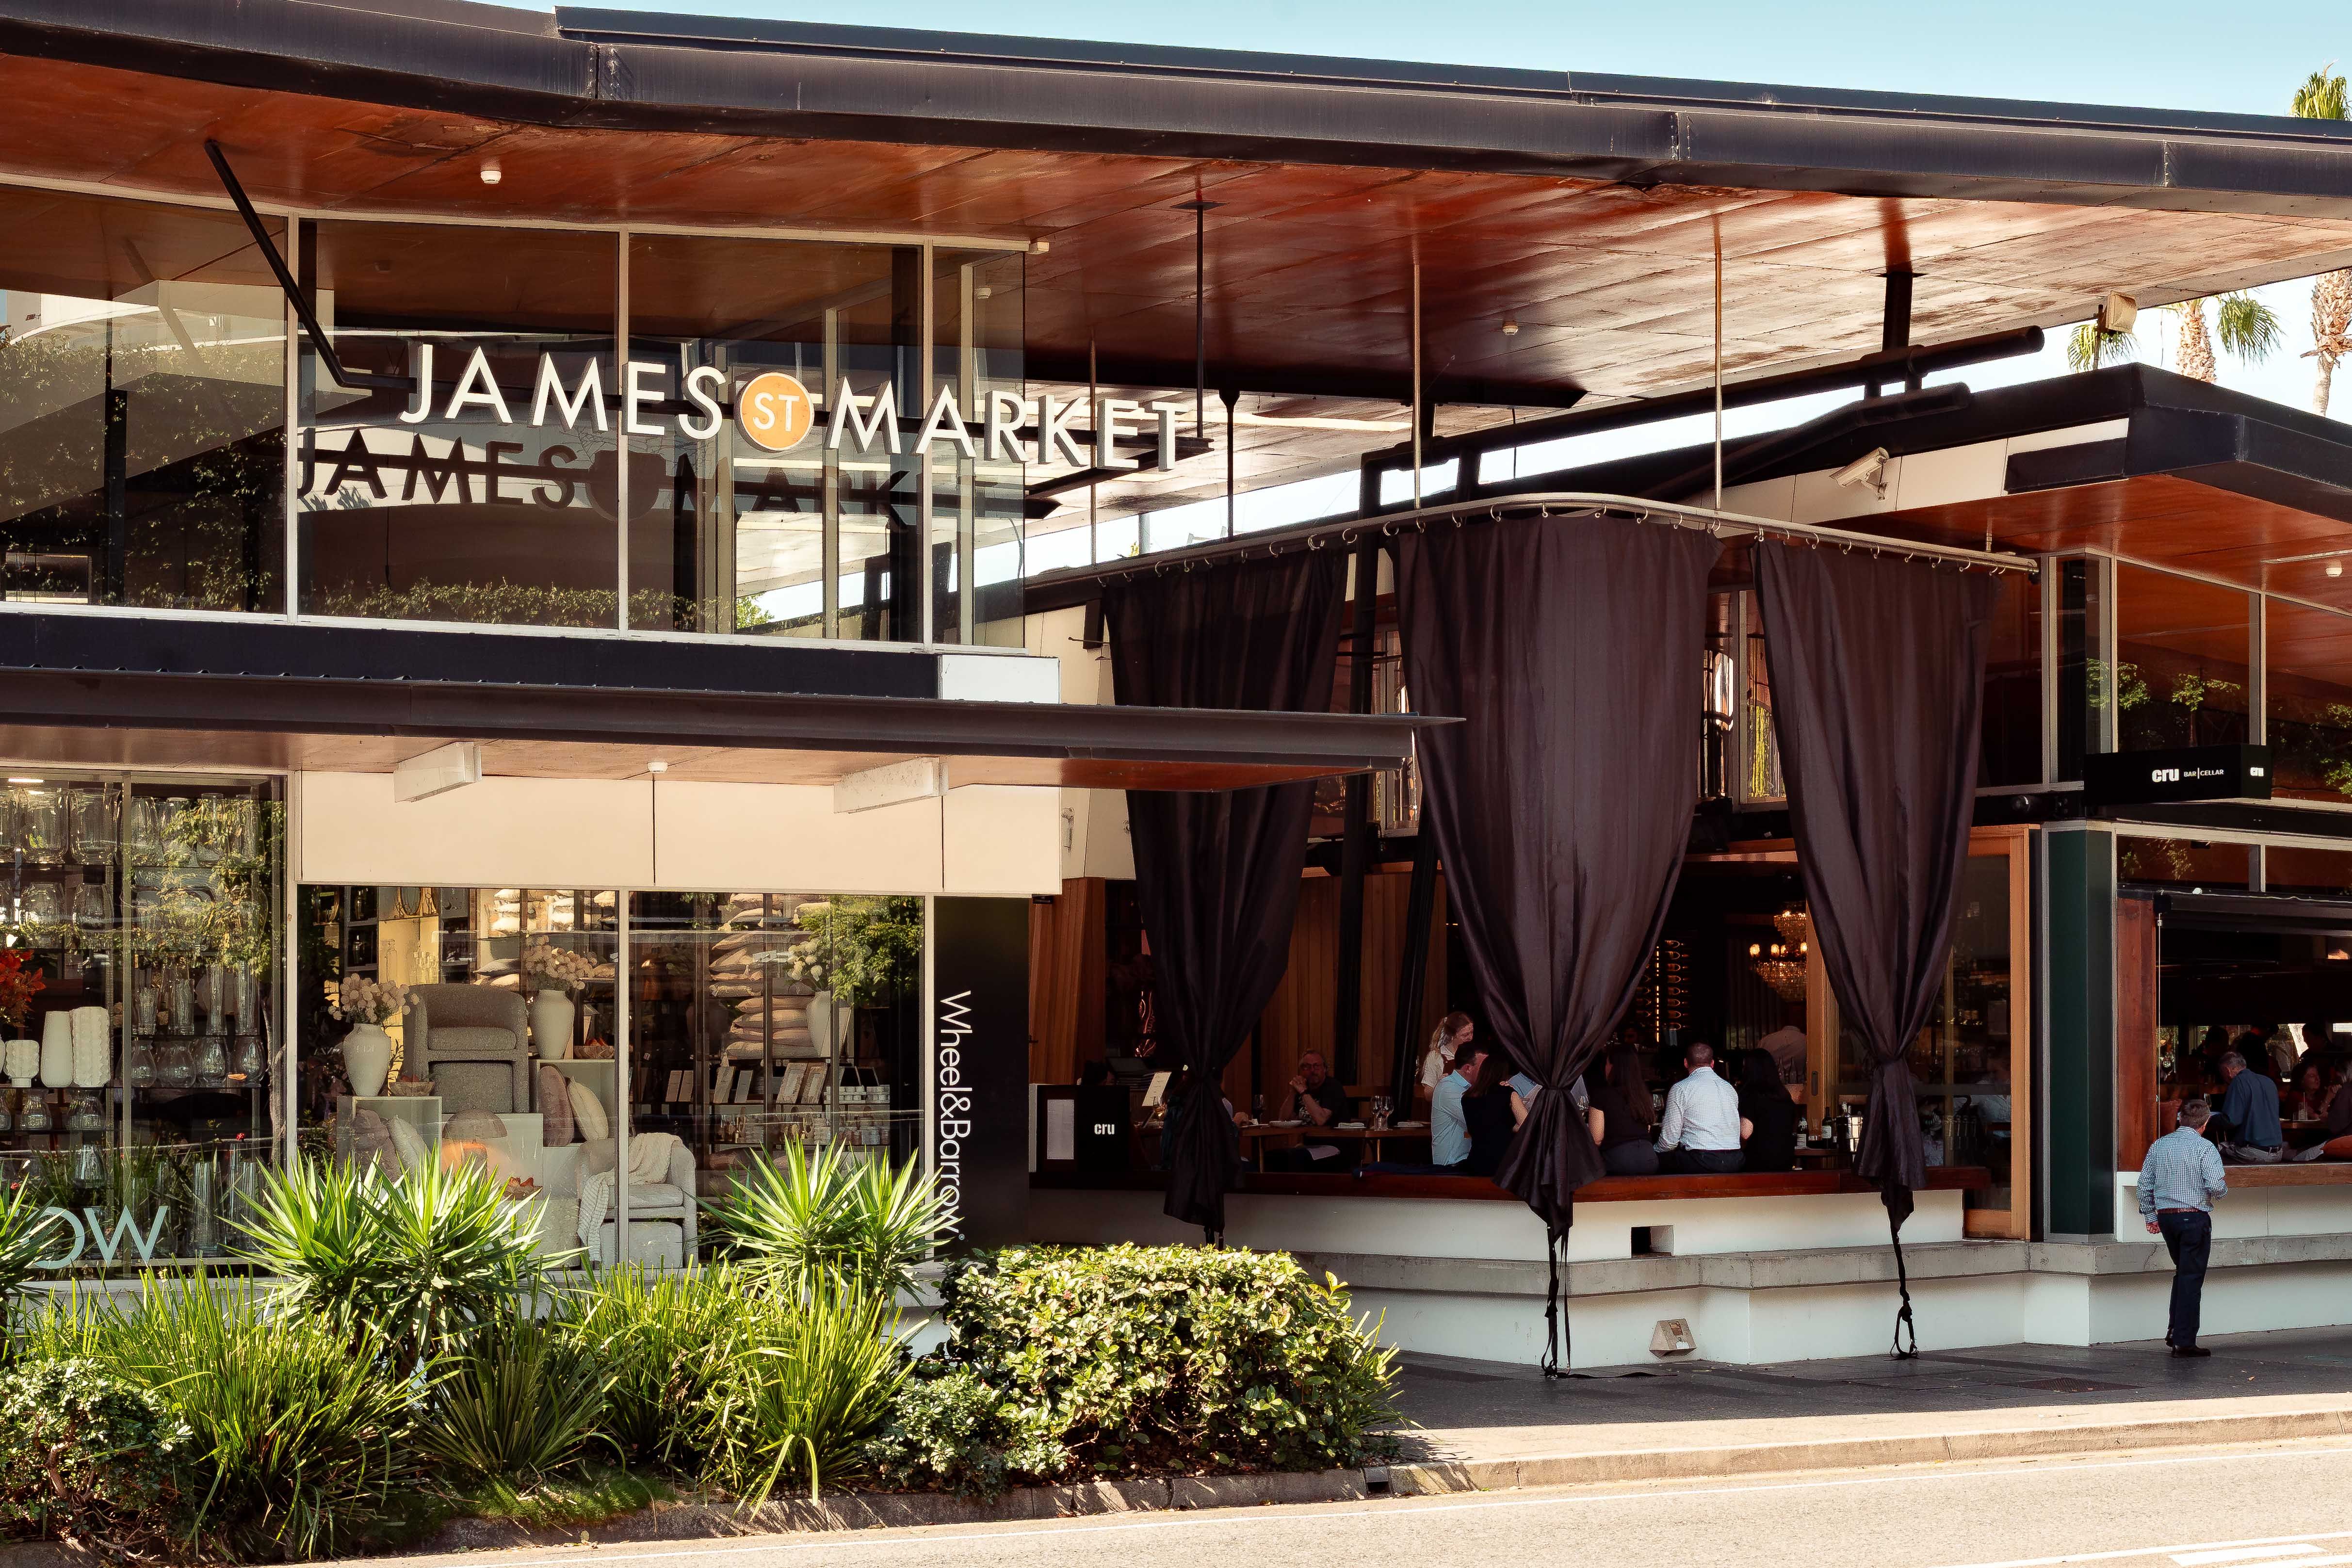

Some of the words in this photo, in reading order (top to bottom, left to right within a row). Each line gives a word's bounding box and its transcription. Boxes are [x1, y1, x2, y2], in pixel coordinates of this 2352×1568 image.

[398, 343, 726, 440] JAMES
[751, 391, 799, 433] ST
[825, 375, 1189, 472] MARKET
[2152, 768, 2179, 782] cru
[1094, 1123, 1115, 1135] cru
